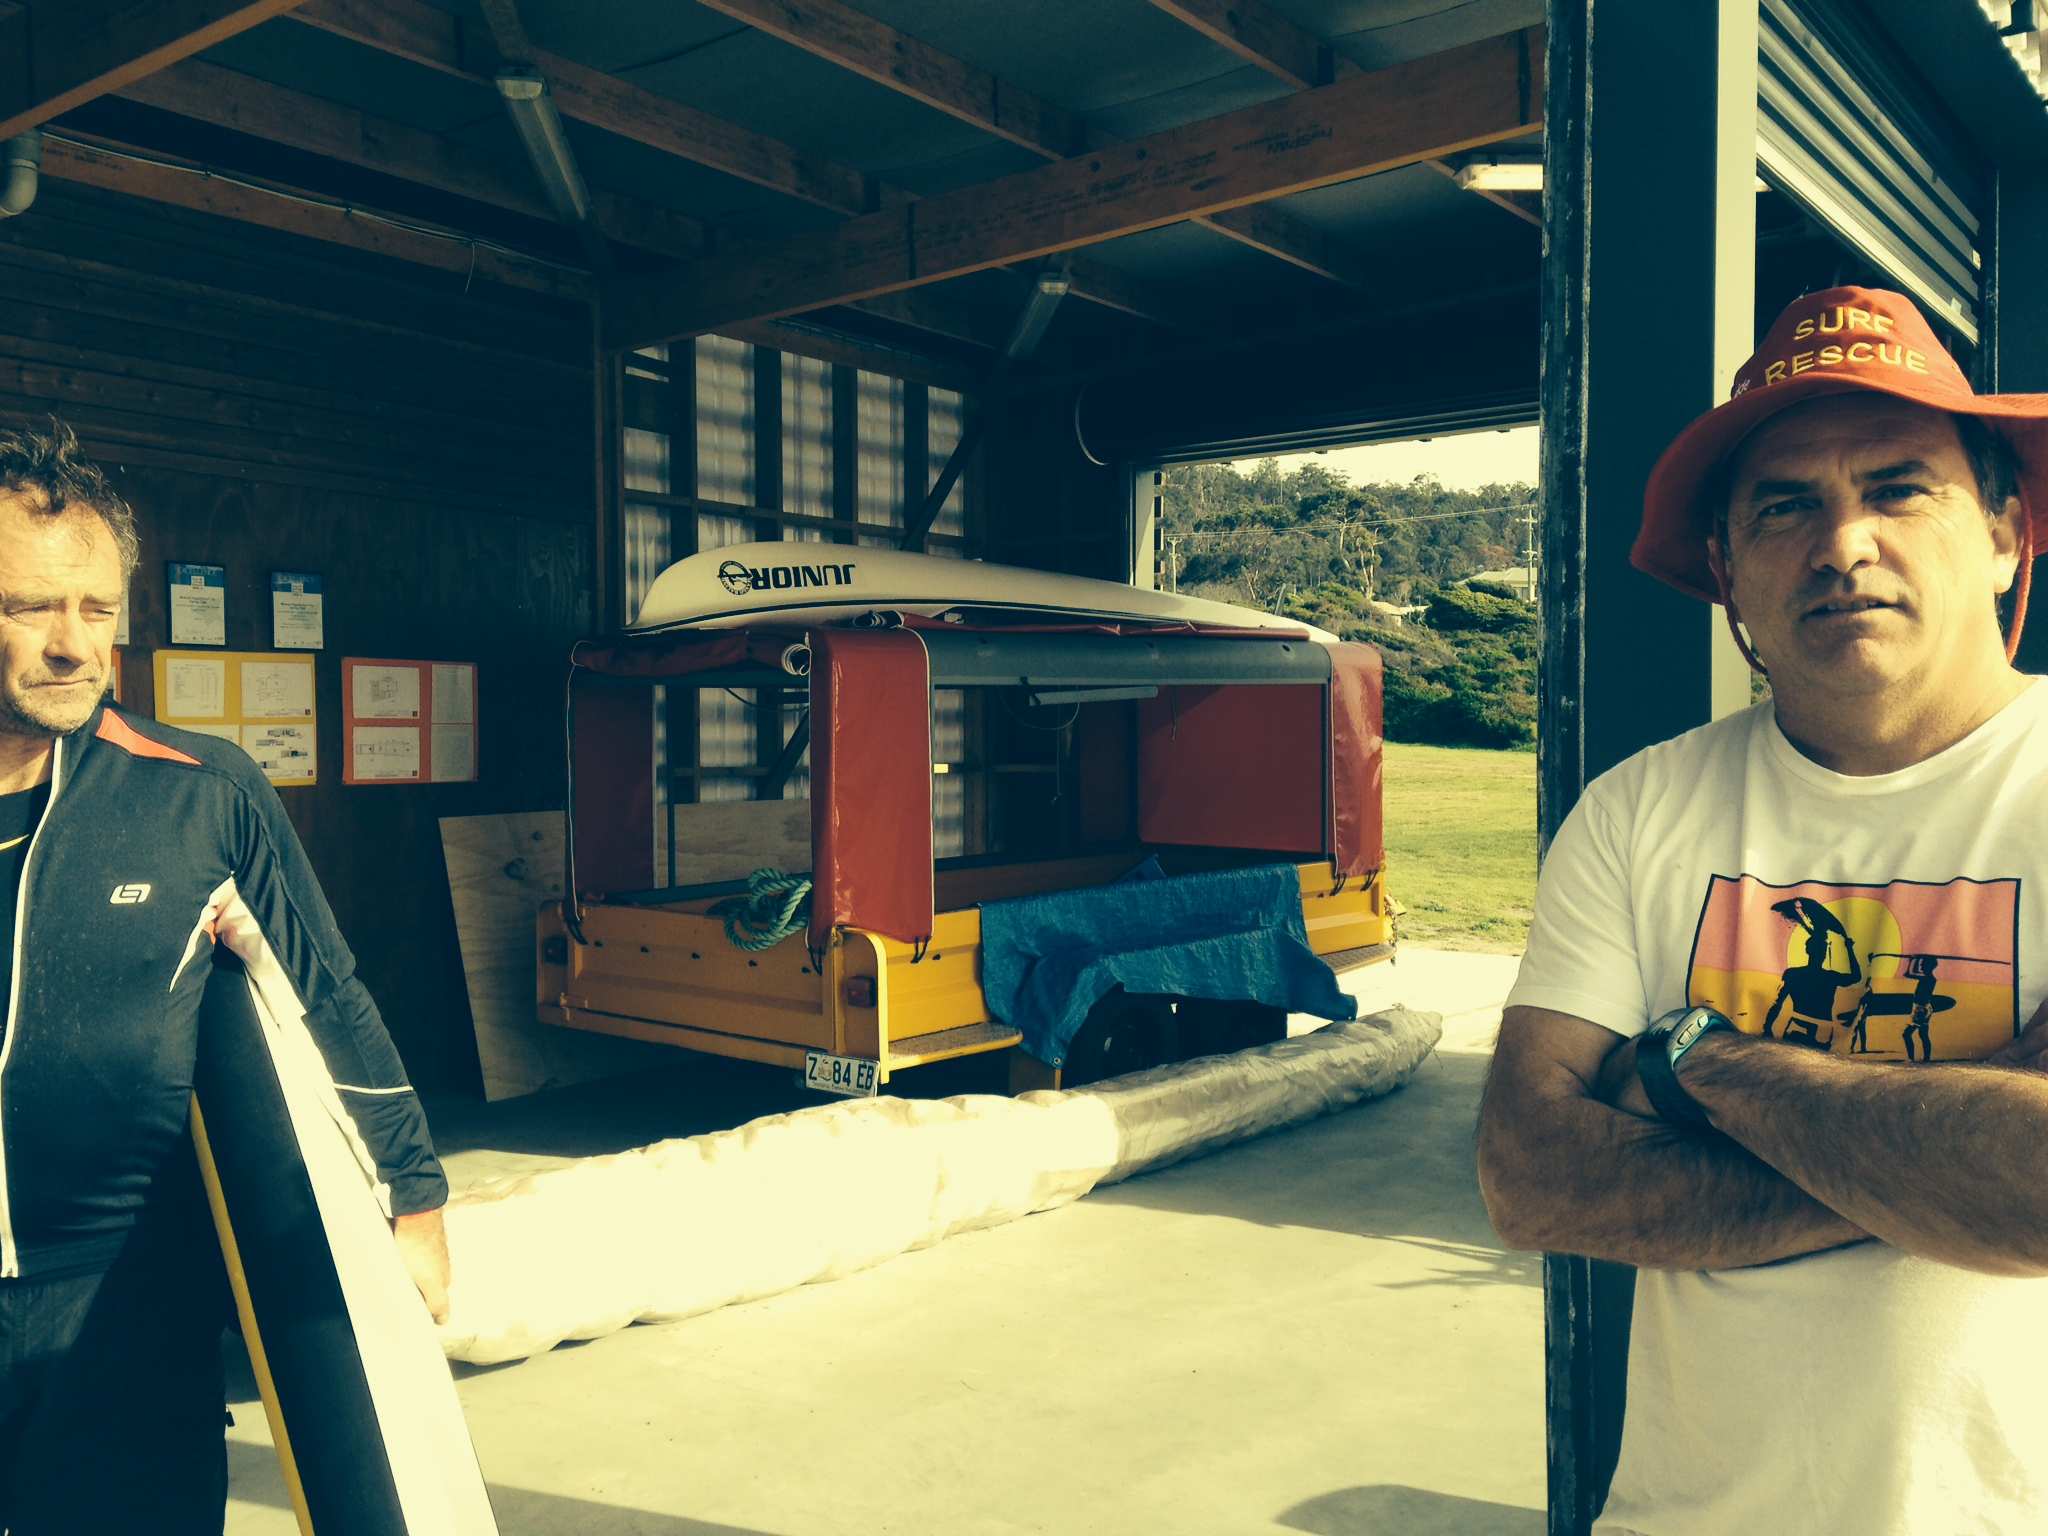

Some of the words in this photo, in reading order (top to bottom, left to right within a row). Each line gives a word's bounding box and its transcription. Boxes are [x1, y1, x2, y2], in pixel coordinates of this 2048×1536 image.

[1794, 305, 1894, 341] SURF
[1764, 342, 1930, 386] RESCUE
[749, 564, 856, 591] JUNIOR
[808, 1056, 818, 1081] Z
[832, 1060, 851, 1087] 84
